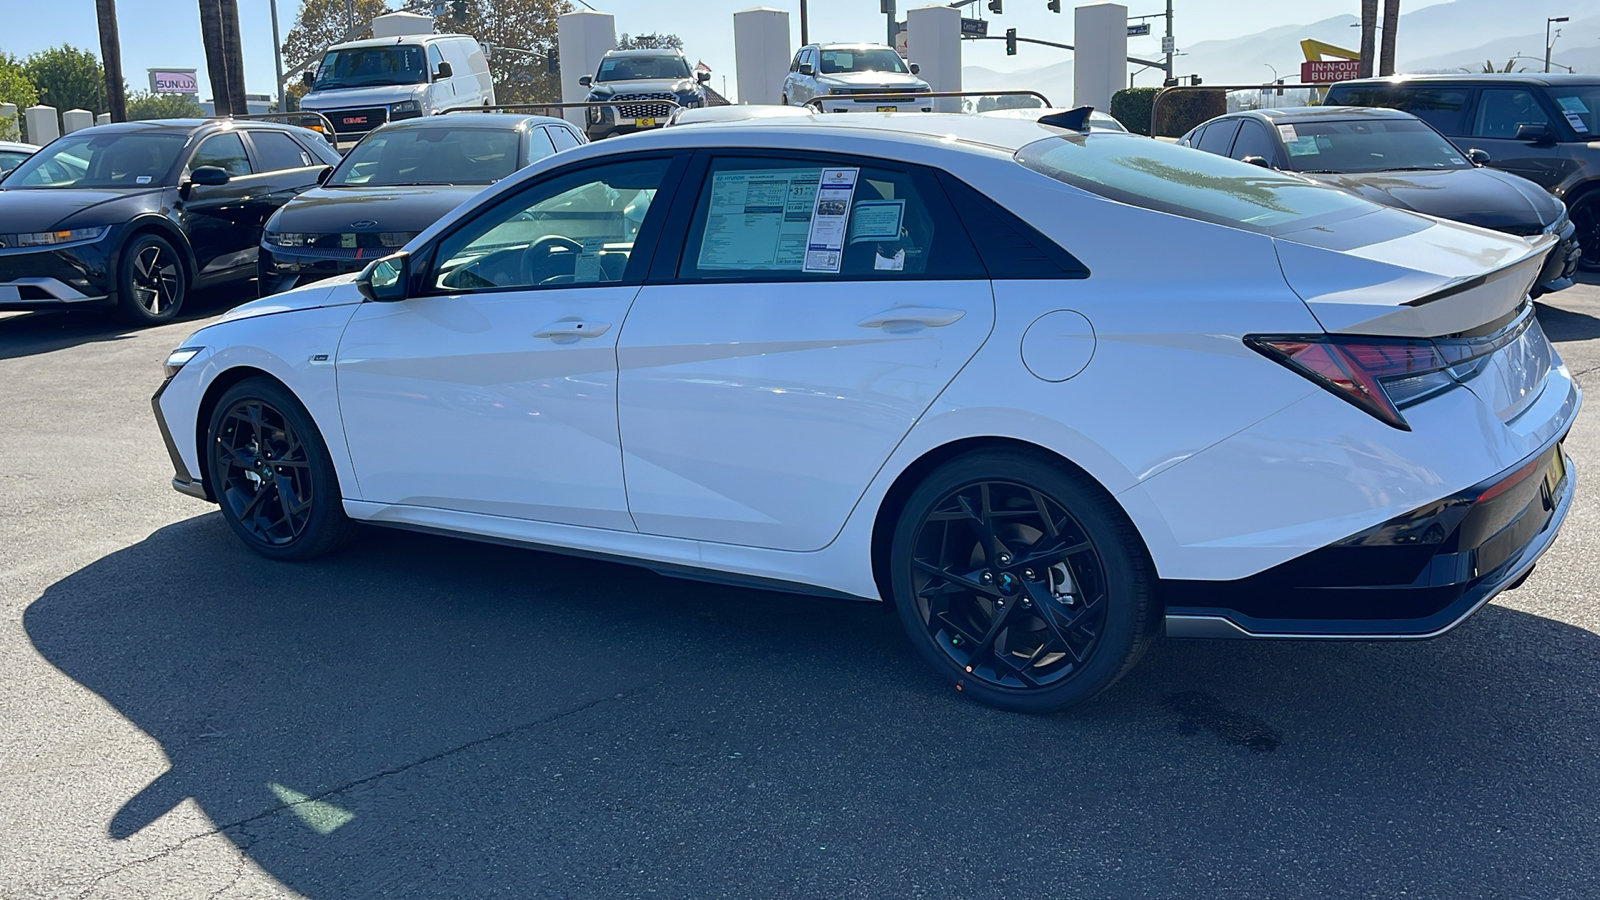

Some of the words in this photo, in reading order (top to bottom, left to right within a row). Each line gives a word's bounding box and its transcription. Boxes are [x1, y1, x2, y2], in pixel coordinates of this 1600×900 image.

[1311, 62, 1360, 71] IN-N-OUT
[1311, 71, 1358, 80] BURGER
[156, 80, 198, 89] SUNLUX
[343, 116, 368, 124] GMC
[793, 187, 803, 195] 31
